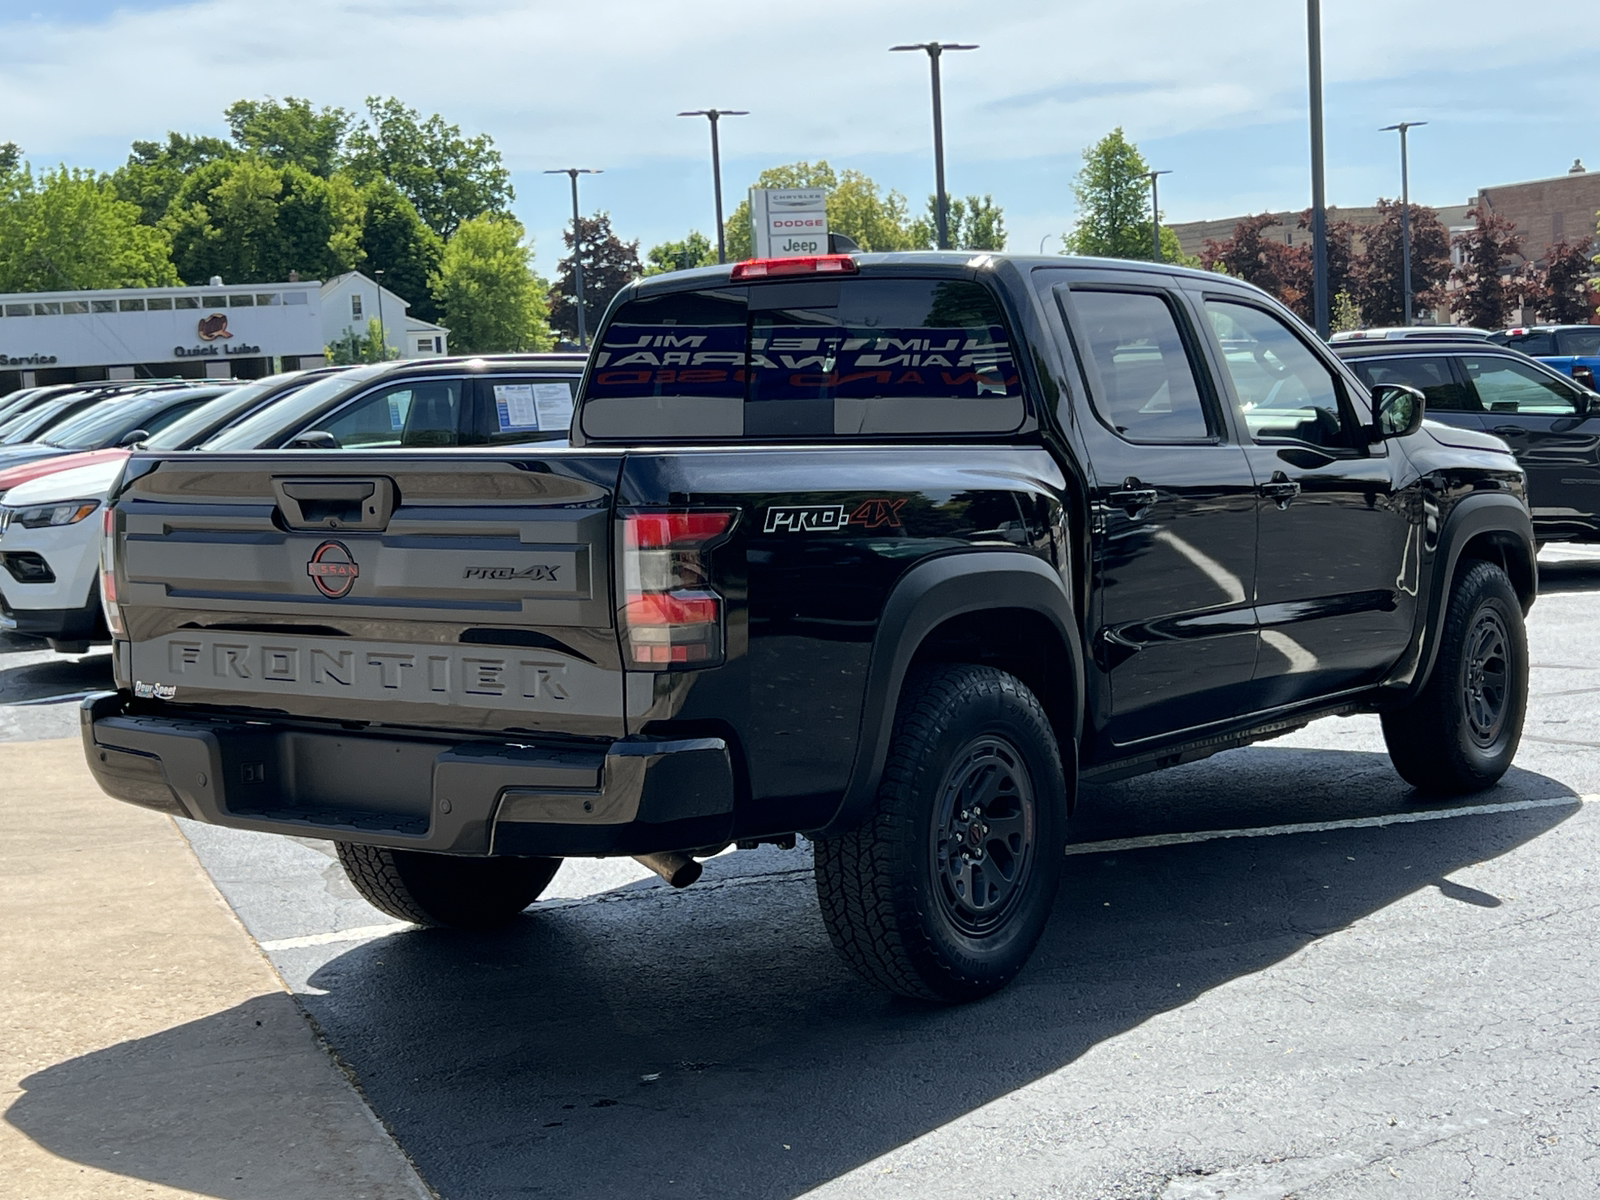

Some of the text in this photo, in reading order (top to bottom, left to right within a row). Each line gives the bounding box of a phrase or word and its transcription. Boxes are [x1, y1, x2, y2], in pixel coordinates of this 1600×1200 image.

[773, 219, 823, 228] DODGE
[783, 239, 817, 254] Jeep
[174, 343, 261, 357] Quick Lube
[0, 353, 57, 366] Service
[309, 564, 357, 575] NSSAN
[168, 639, 571, 701] FRONTIER
